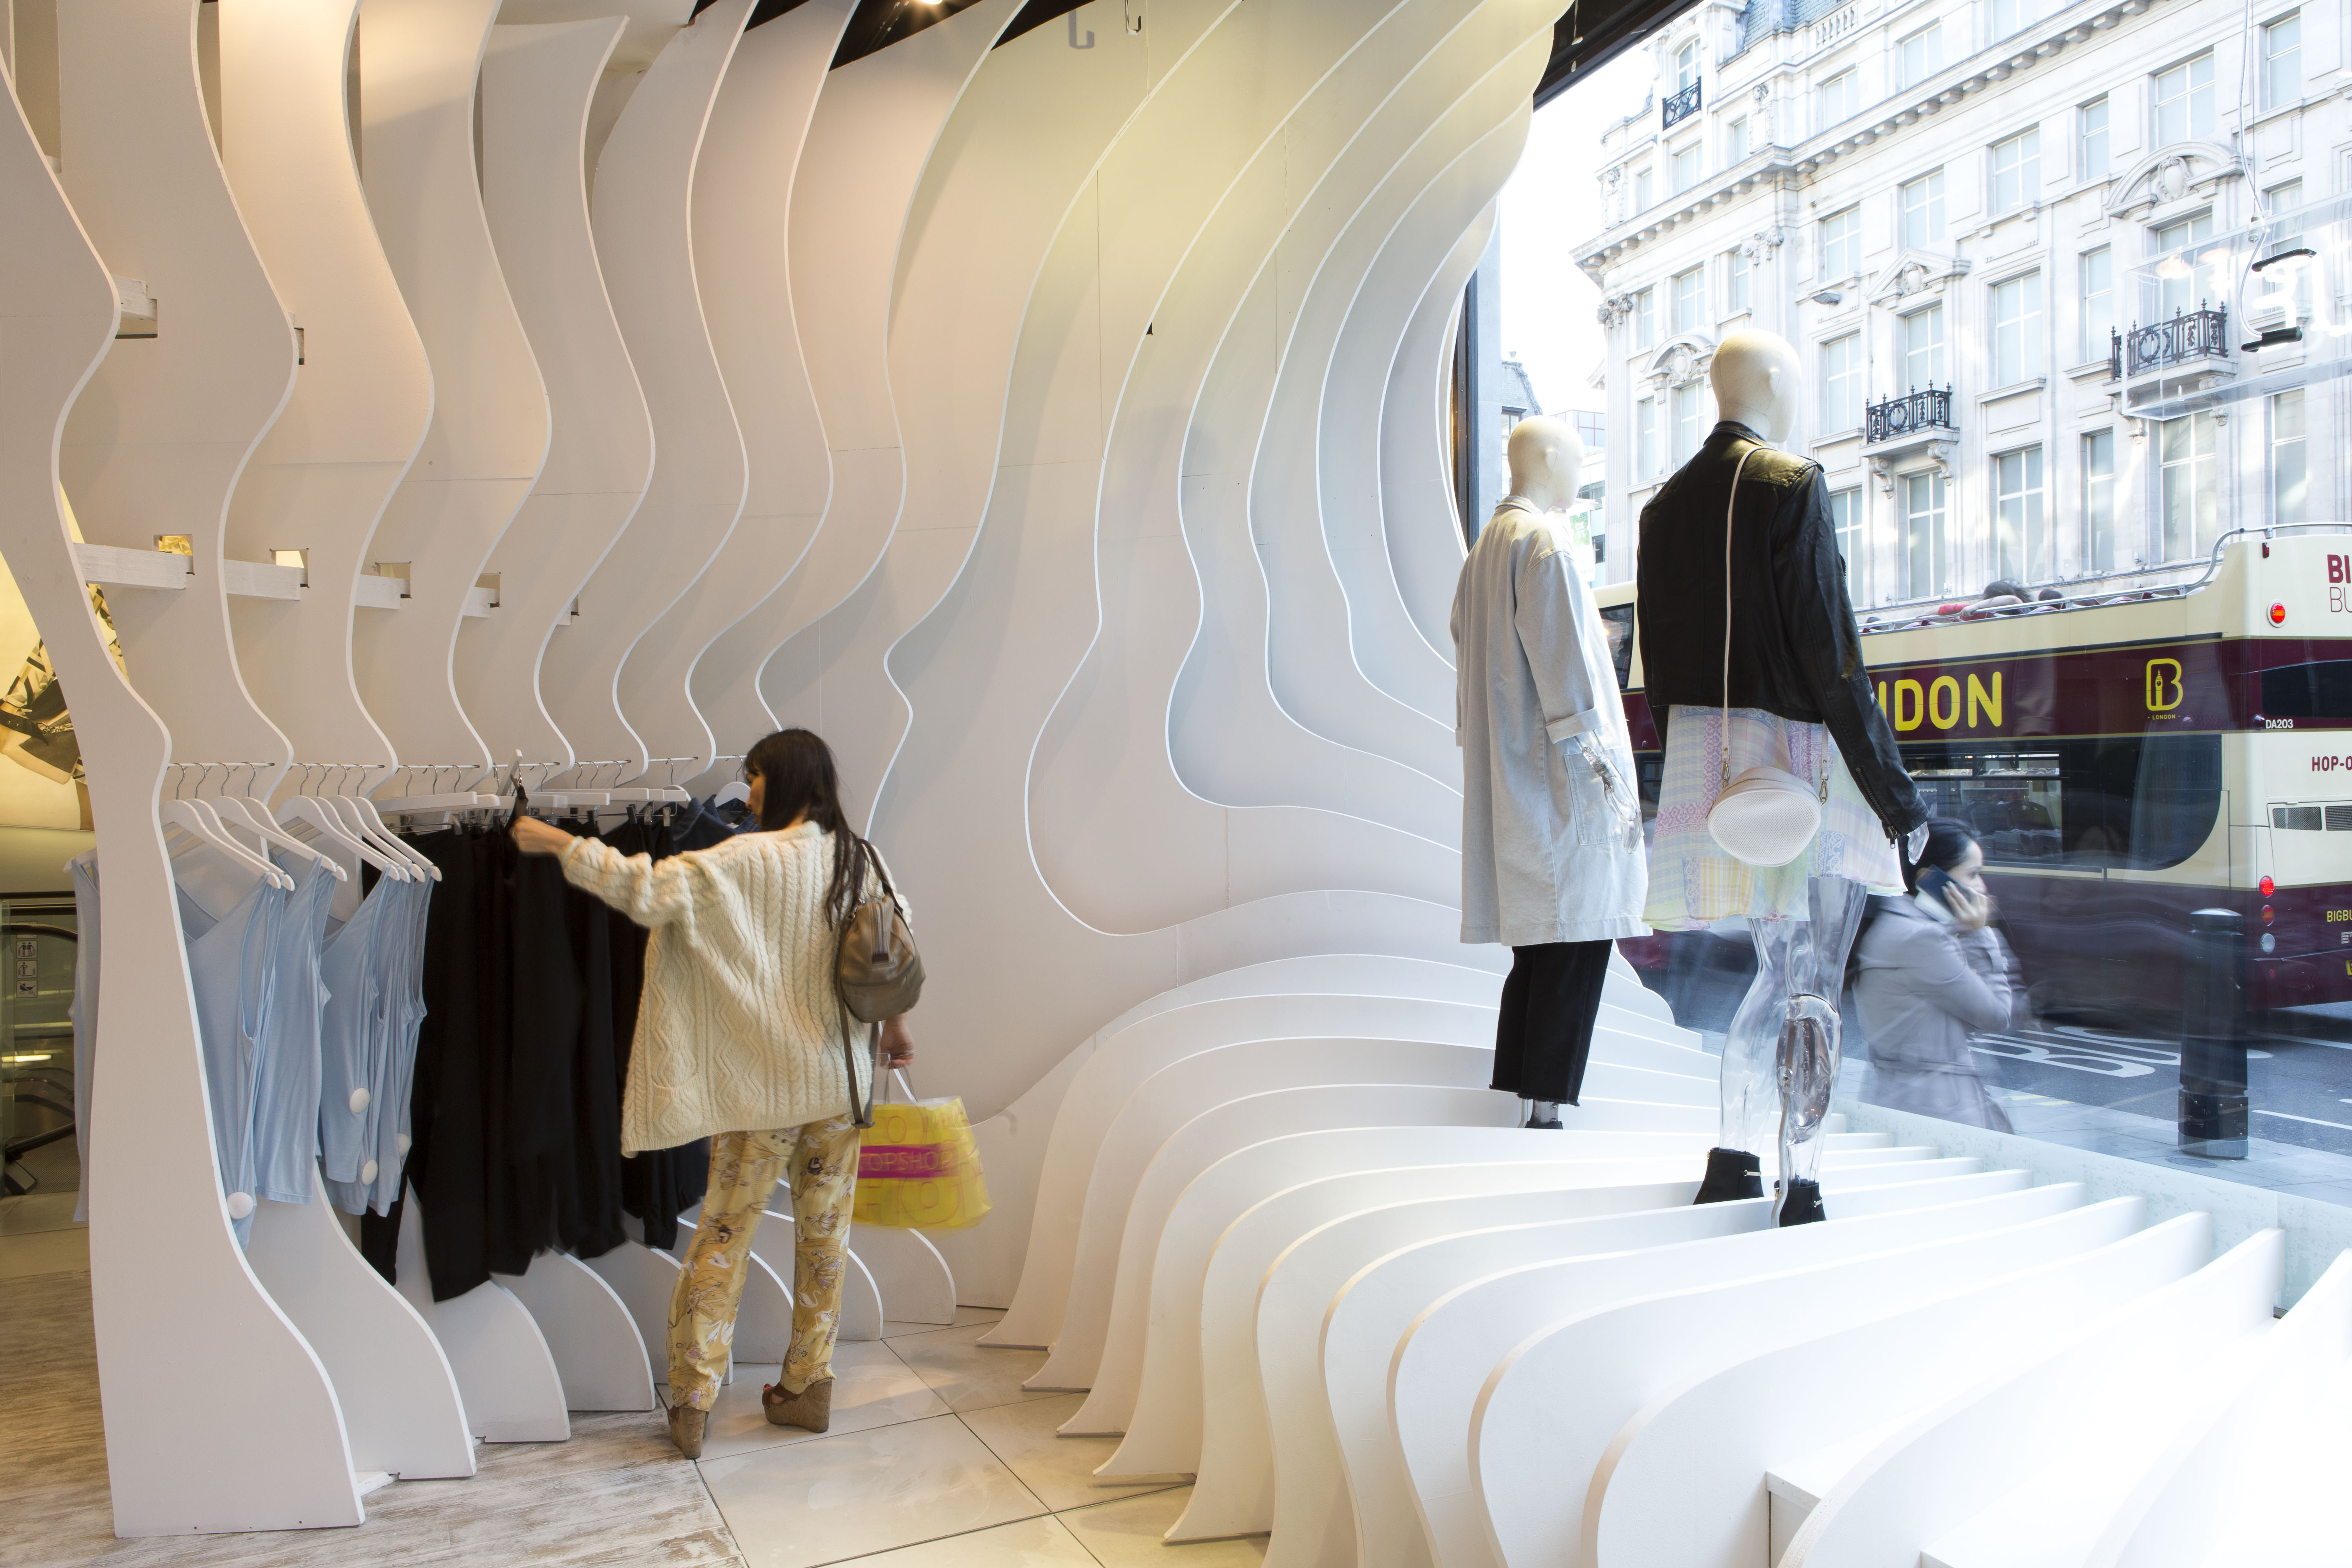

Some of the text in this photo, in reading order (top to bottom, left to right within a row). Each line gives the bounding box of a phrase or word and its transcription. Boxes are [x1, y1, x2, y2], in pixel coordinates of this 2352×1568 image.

[2327, 554, 2351, 584] BI
[1878, 671, 2002, 731] DON
[2265, 719, 2293, 729] DA203
[2312, 755, 2352, 772] HOP-O
